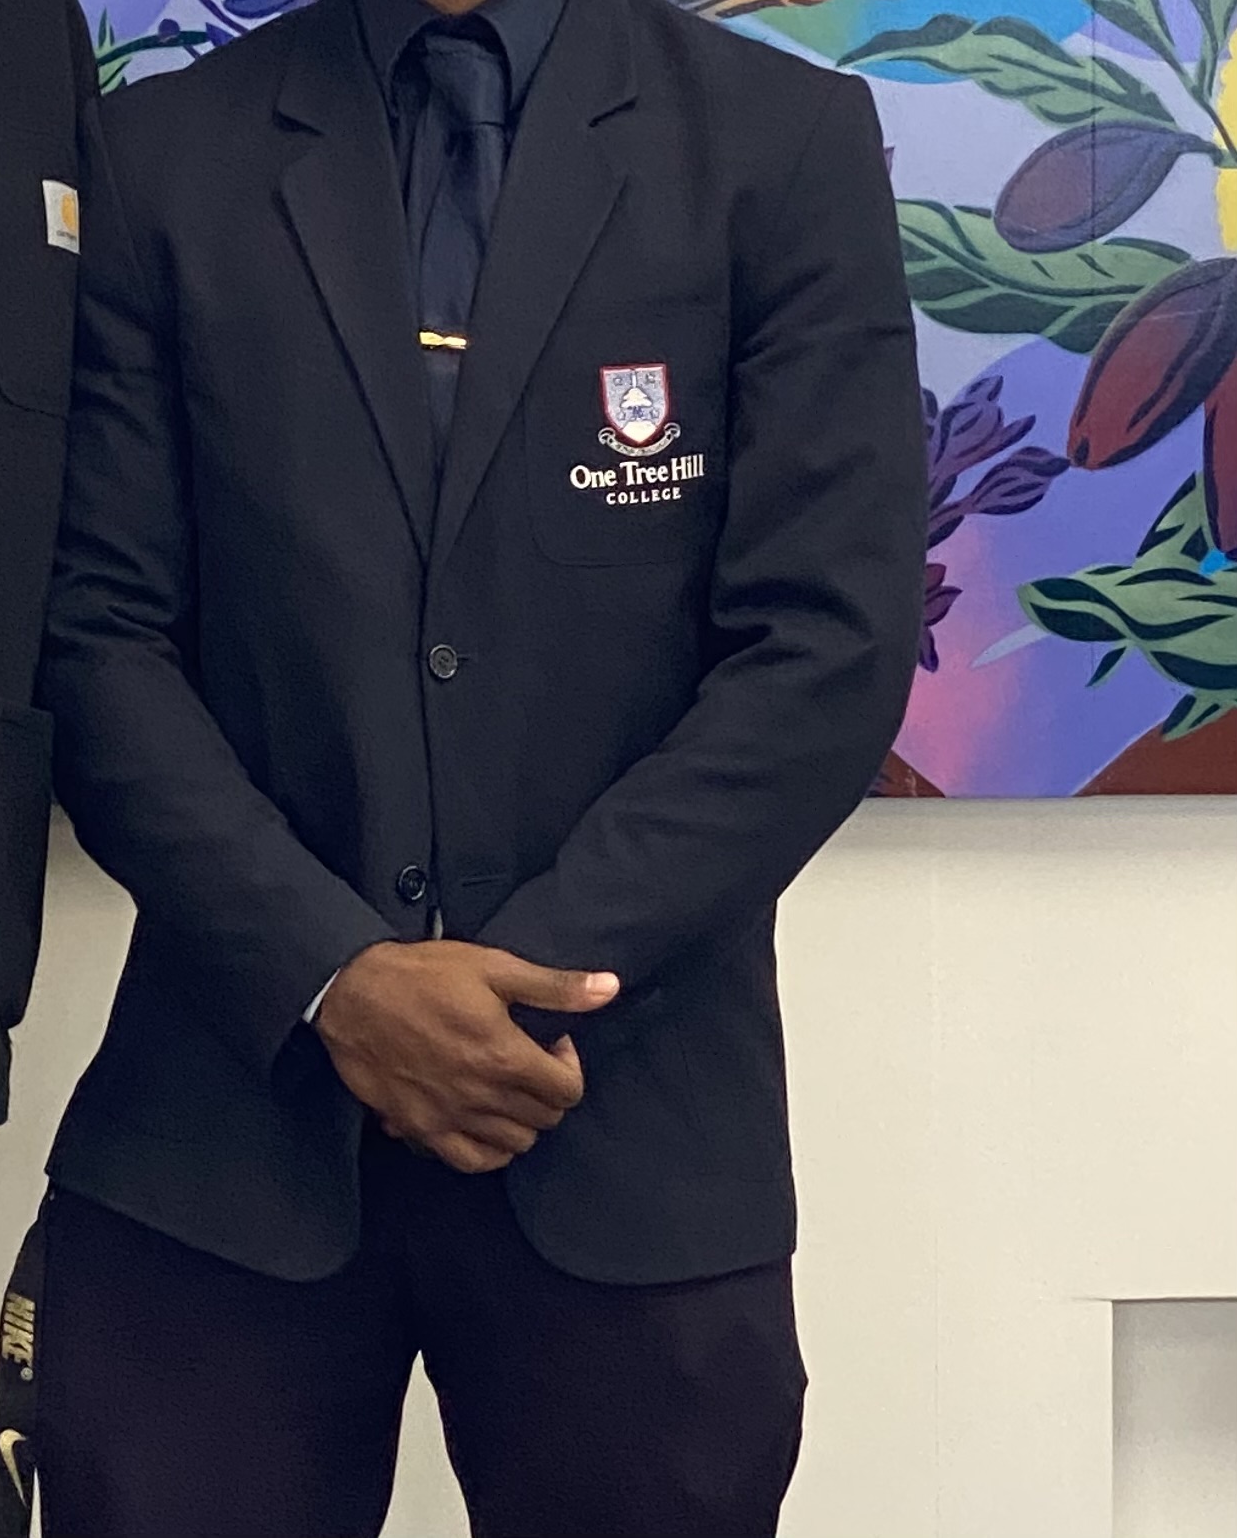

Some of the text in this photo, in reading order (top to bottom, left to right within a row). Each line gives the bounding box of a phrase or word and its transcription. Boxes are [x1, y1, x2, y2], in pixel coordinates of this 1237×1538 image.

[570, 454, 705, 489] One Tree Hill
[606, 487, 682, 505] COLLEGE
